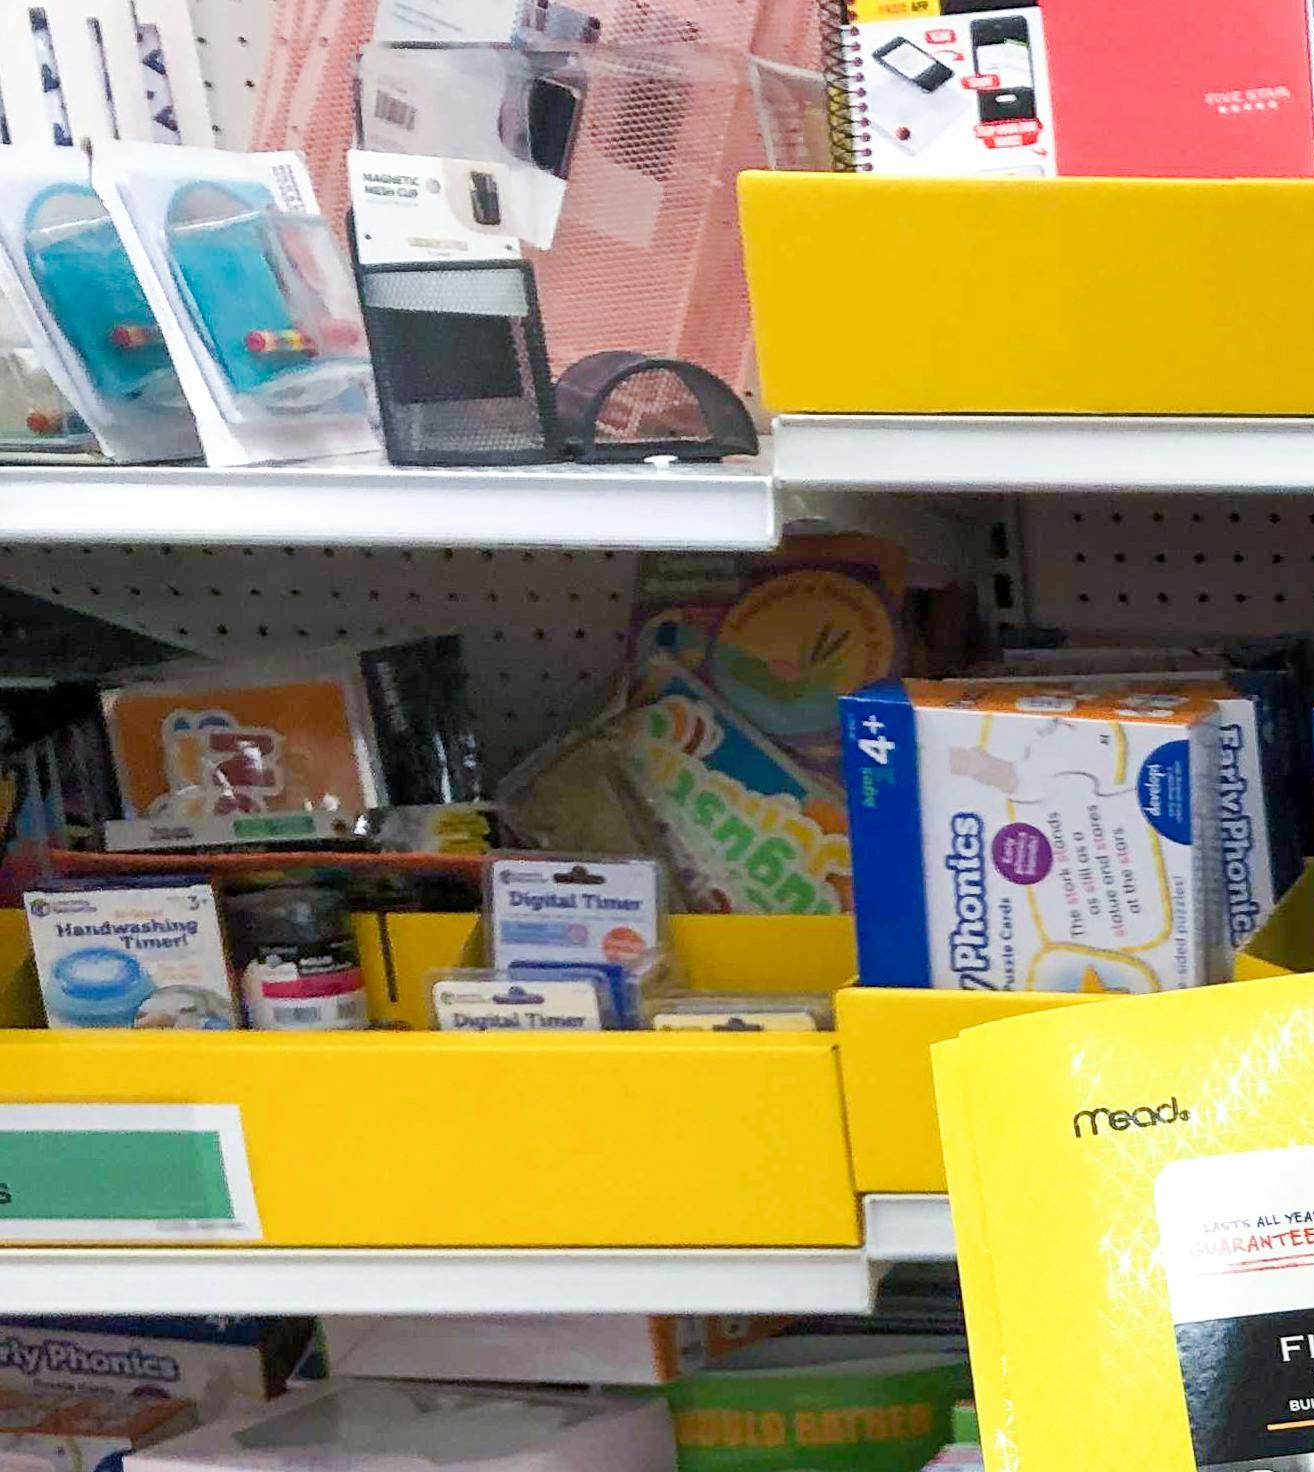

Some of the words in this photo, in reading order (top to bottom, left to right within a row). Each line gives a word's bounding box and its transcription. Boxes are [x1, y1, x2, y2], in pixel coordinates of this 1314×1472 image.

[857, 715, 895, 765] 4+
[1142, 763, 1164, 818] develops
[1098, 854, 1116, 887] and
[508, 889, 576, 912] Digital
[579, 893, 643, 911] Timer
[945, 812, 991, 982] Phonics
[1002, 896, 1015, 929] Cards
[56, 918, 199, 939] Handwashing
[1068, 907, 1084, 939] The
[453, 1012, 512, 1030] Digital
[515, 1012, 587, 1029] Timer
[1203, 1217, 1252, 1235] LASTS
[1256, 1212, 1282, 1229] ALL
[42, 1339, 180, 1381] Phonics
